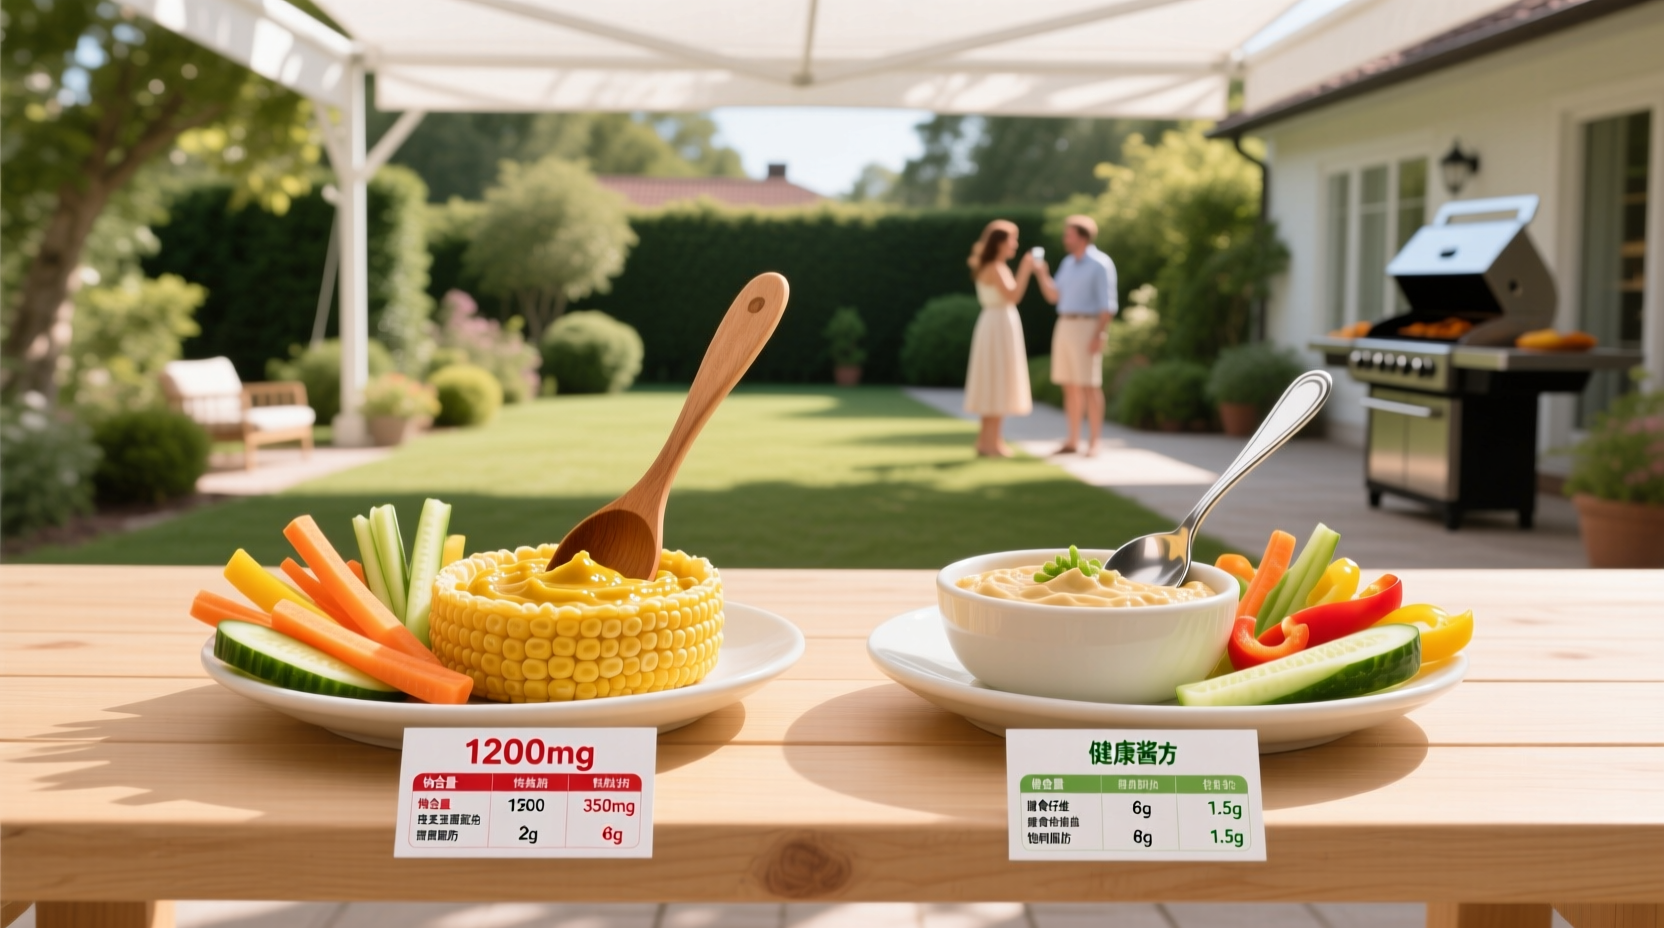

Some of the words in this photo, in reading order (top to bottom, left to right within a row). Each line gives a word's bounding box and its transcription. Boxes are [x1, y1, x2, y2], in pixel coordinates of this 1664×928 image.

[465, 738, 595, 772] 1200mg
[1089, 740, 1178, 766] 健康酱方
[583, 798, 635, 816] 350mg
[1132, 800, 1152, 819] 6g
[1207, 800, 1242, 820] 1.5g
[518, 825, 538, 844] 2g
[1210, 829, 1244, 848] 1.5g
